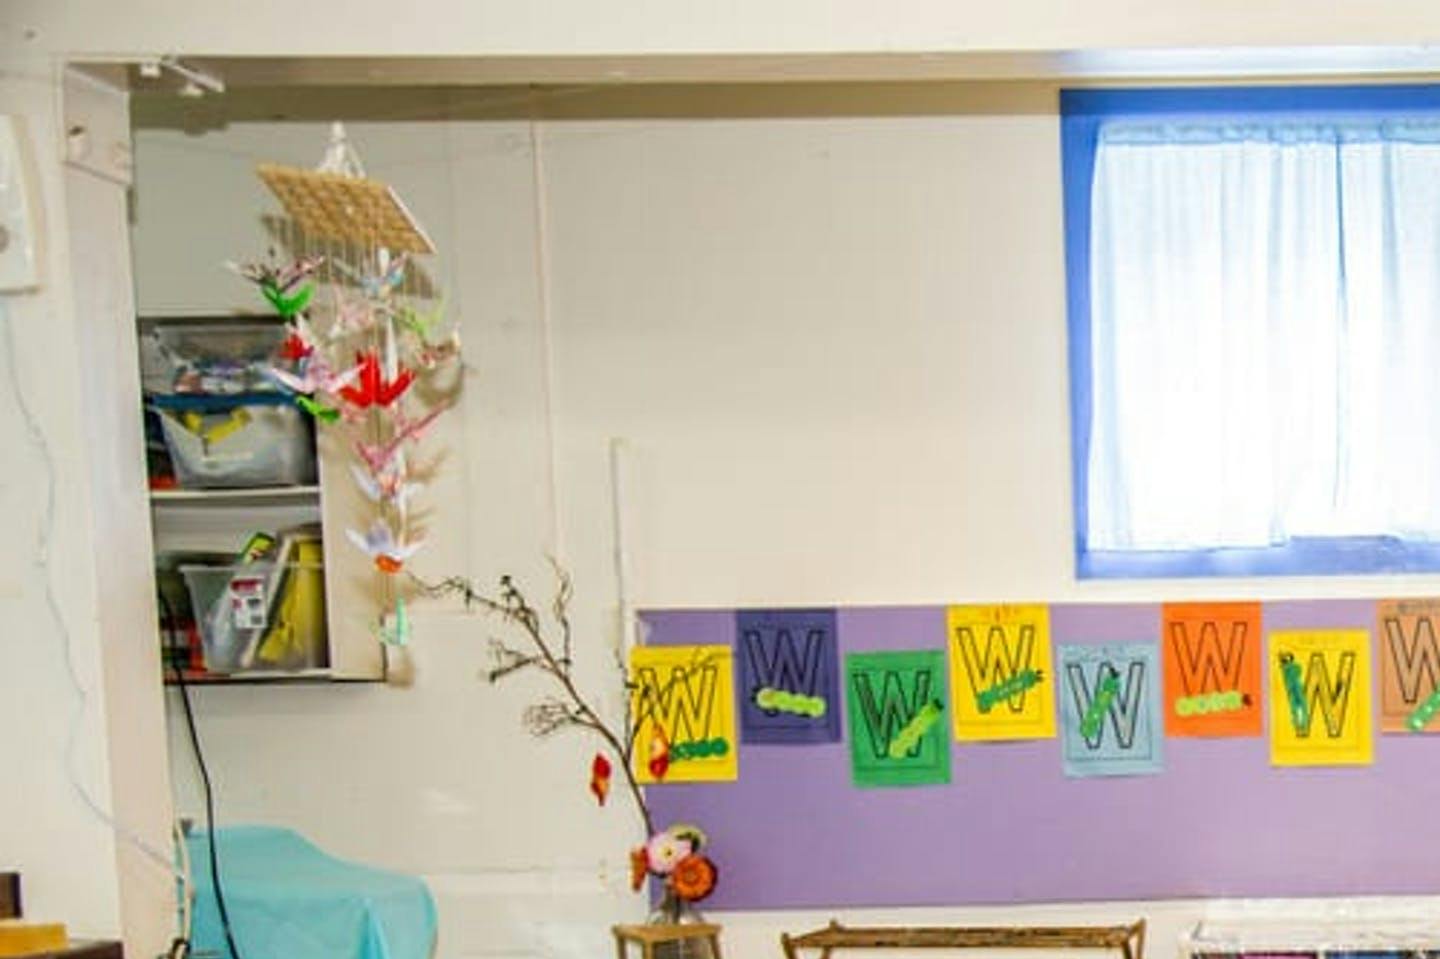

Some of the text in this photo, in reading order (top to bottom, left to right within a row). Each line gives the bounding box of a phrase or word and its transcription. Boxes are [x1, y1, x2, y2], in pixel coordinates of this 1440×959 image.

[743, 628, 825, 716] W
[956, 624, 1035, 712] W
[1066, 661, 1145, 749] W
[1169, 621, 1248, 708] W
[1278, 652, 1356, 738] W
[639, 664, 718, 756] W
[852, 670, 931, 758] W
